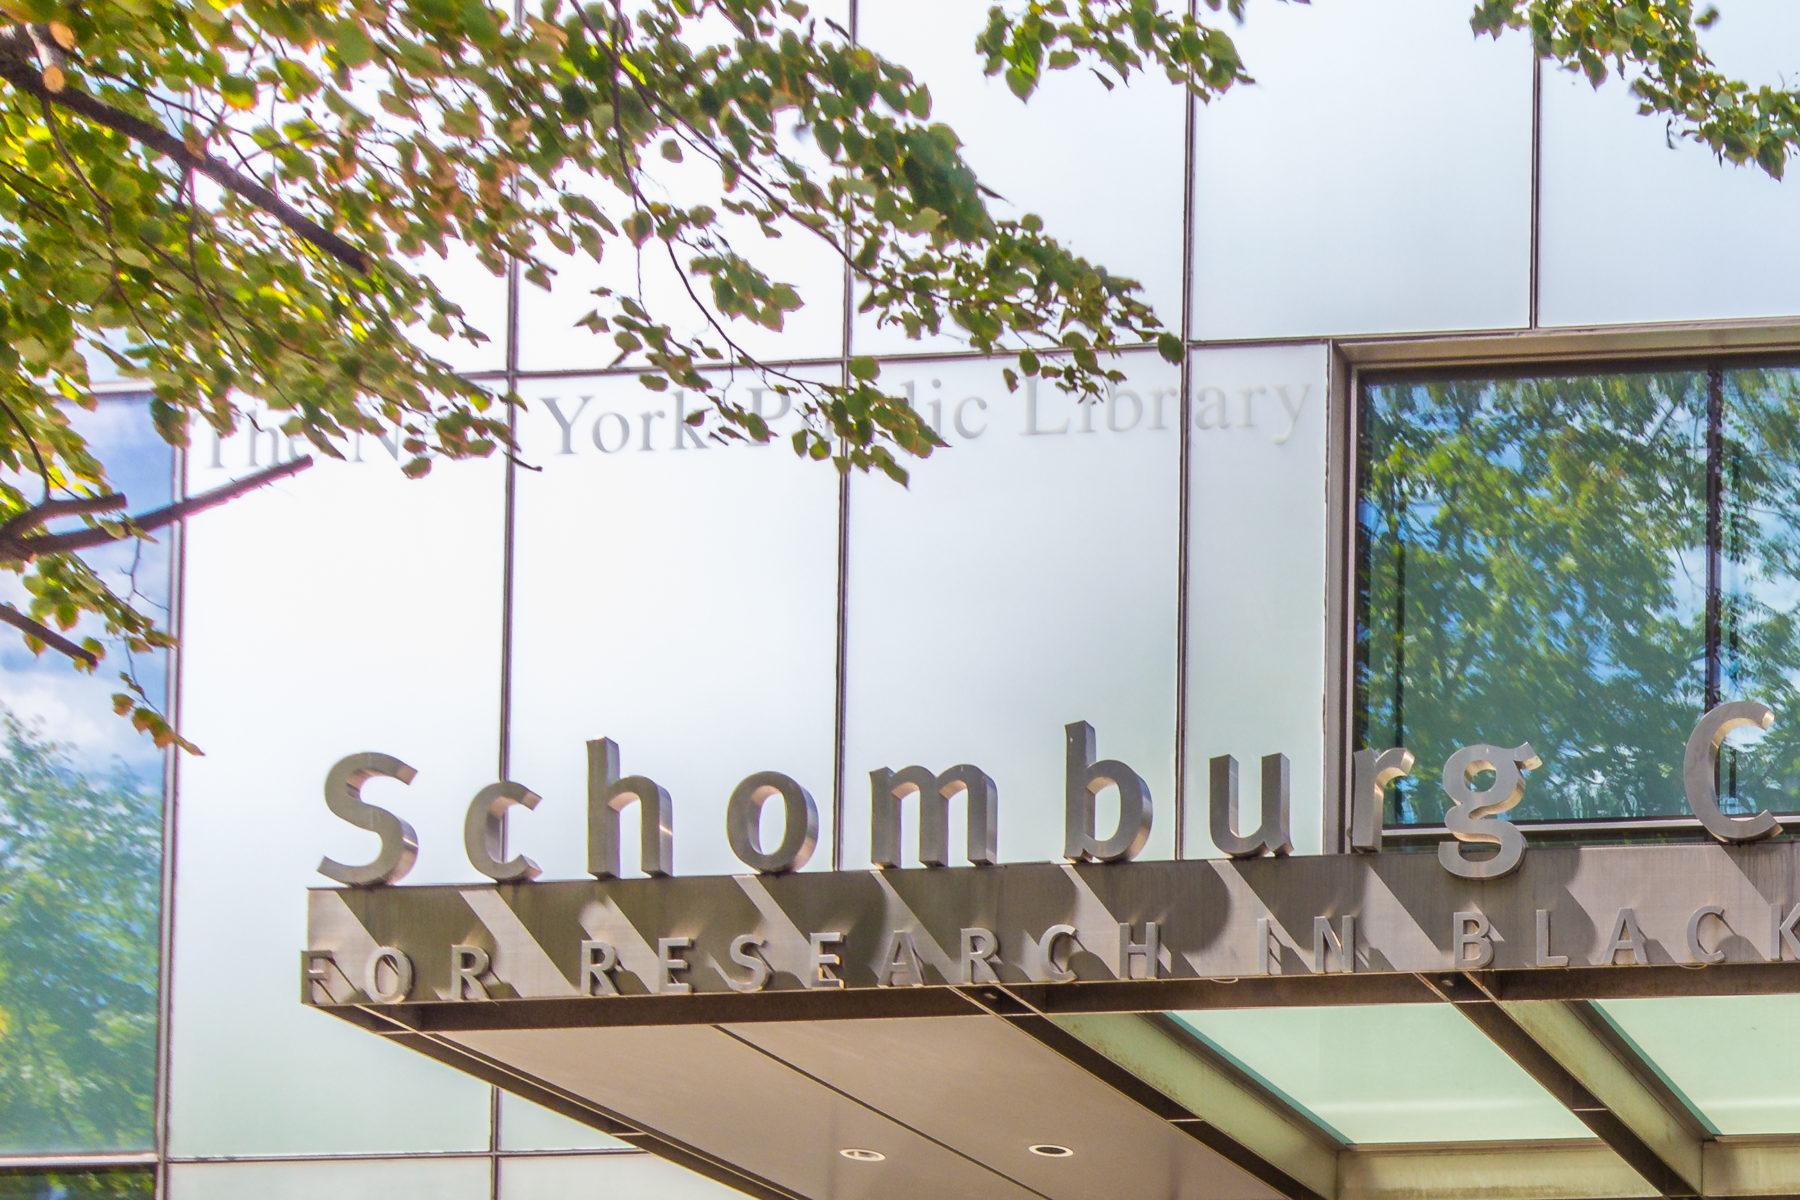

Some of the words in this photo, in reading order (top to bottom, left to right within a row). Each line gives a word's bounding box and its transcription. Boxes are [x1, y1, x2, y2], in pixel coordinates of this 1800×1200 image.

[541, 390, 711, 456] York
[745, 378, 988, 447] Plic
[1019, 374, 1312, 446] Library
[317, 719, 1543, 885] Schomburg
[301, 943, 491, 1003] FOR
[580, 921, 1163, 995] RESEARCH
[1257, 914, 1356, 976] IN
